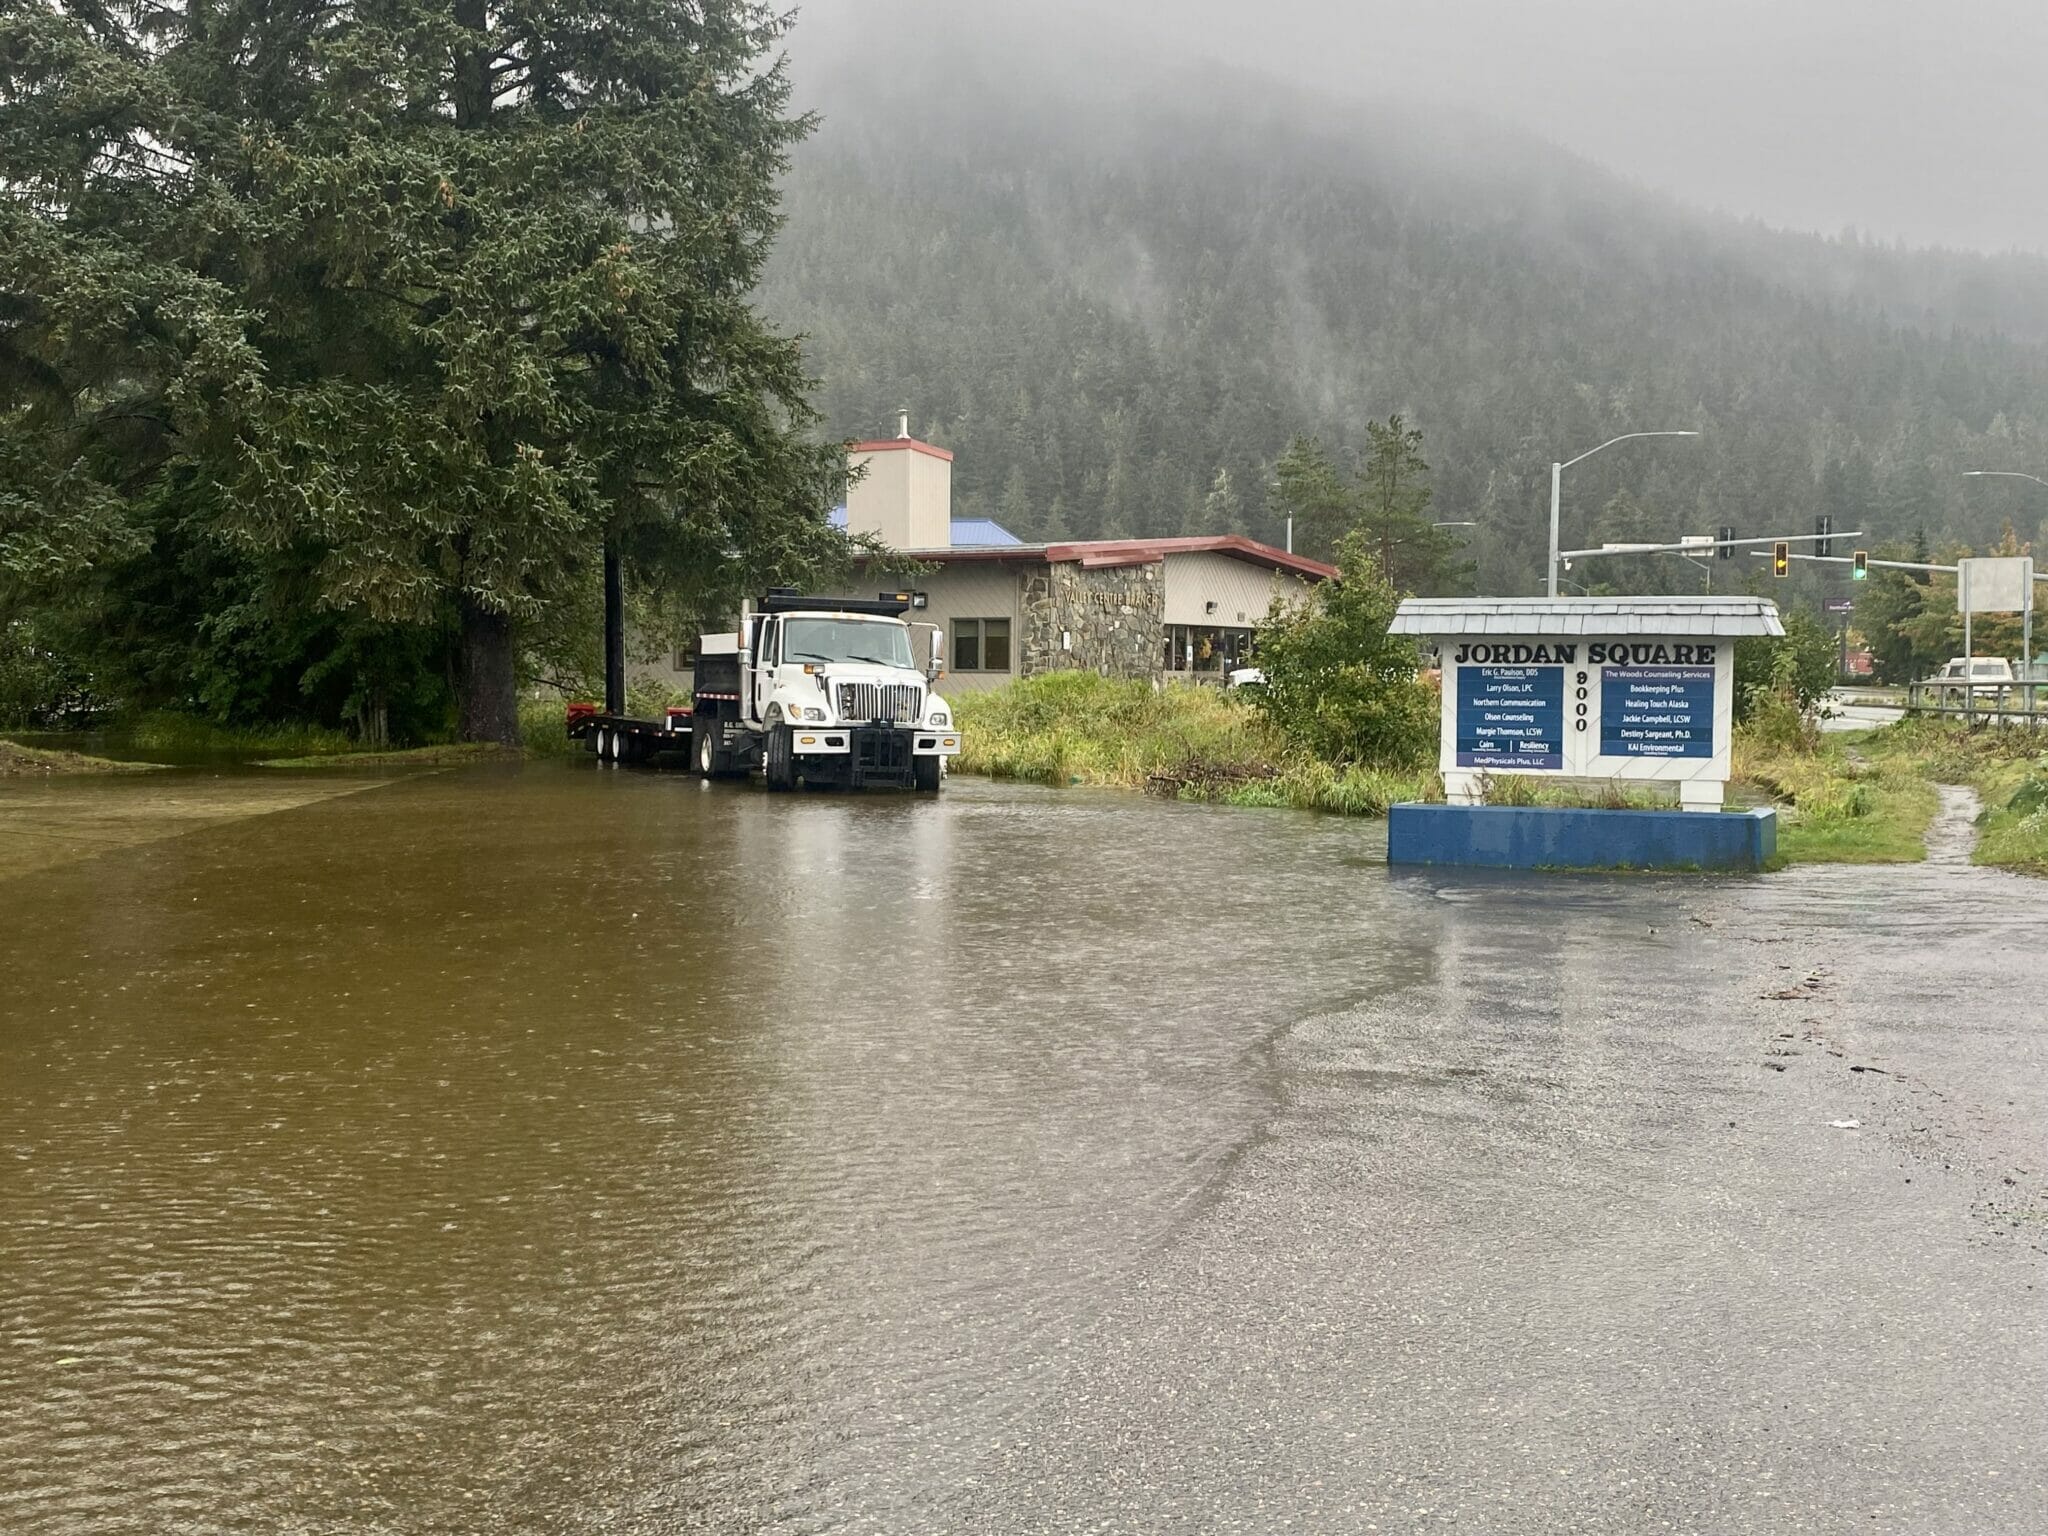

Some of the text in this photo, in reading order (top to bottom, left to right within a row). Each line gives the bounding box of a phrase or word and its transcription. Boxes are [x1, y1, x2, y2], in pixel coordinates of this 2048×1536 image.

[1094, 591, 1123, 605] CENTRE
[1454, 643, 1716, 667] JORDAN SQUARE
[1482, 668, 1493, 677] Eric
[1526, 669, 1539, 677] DDS
[1619, 671, 1643, 679] Woods
[1643, 671, 1682, 681] Counseling
[1682, 671, 1711, 679] Services
[1486, 684, 1534, 693] Larry Olson, LPC
[1630, 685, 1685, 694] Bookkeeping Plus
[1473, 699, 1547, 708] Northern Communication
[1625, 700, 1690, 709] Healing Touch Alaska
[1484, 713, 1535, 723] Olson Counseling
[1622, 715, 1692, 725] Jackie Campbell, LCSW
[1476, 727, 1497, 737] Margie
[1526, 728, 1544, 736] LCSW
[1620, 730, 1644, 739] Destiny
[1644, 730, 1674, 740] Sargeant,
[1520, 741, 1550, 751] Resiliency
[1628, 744, 1685, 753] KAI Environmental
[1473, 757, 1516, 766] MedPhysicals
[1532, 758, 1545, 766] LLC
